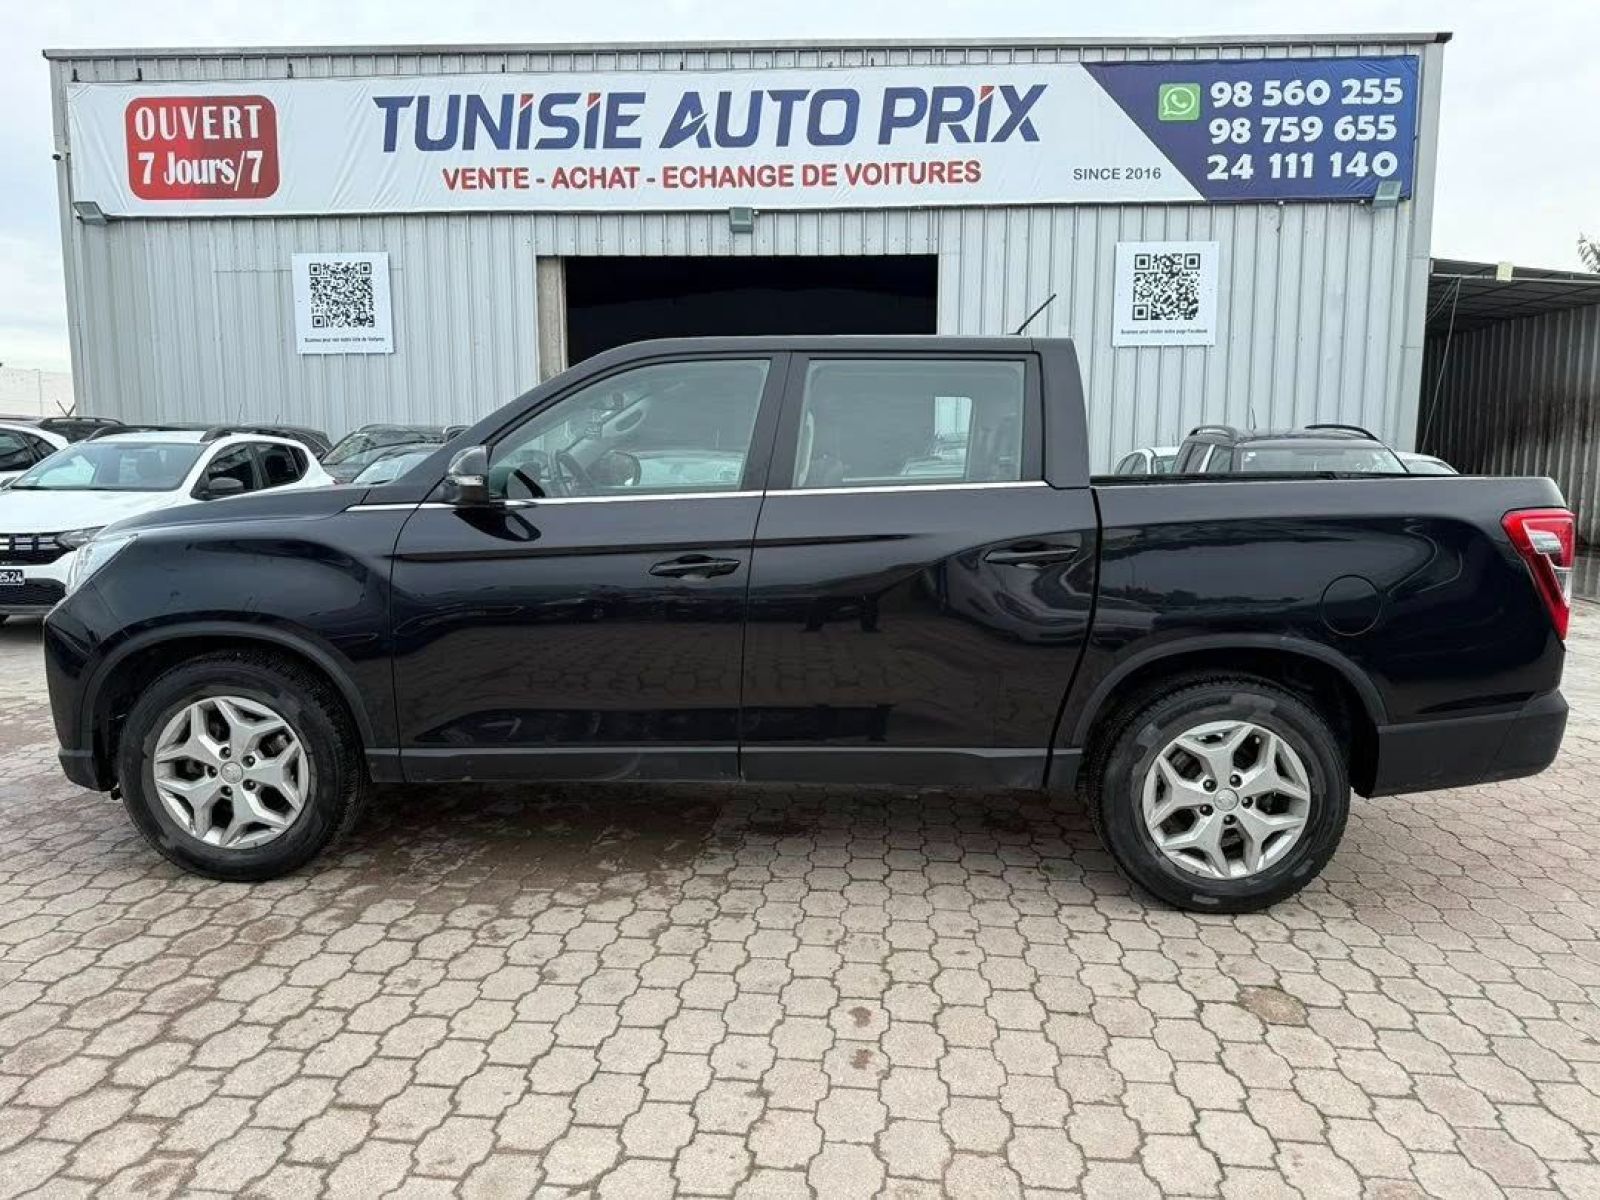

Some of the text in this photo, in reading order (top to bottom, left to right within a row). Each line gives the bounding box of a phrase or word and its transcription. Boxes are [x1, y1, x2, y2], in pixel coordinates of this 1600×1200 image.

[1210, 77, 1404, 107] 98 560 255
[134, 104, 263, 141] OUVERT
[372, 84, 1048, 152] TUNISIE AUTO PRIX
[1208, 115, 1397, 144] 98 759 655
[137, 150, 264, 191] 7 Jours/7
[442, 166, 529, 191] VENTE
[551, 165, 641, 190] ACHAT
[663, 164, 795, 189] ECHANGE
[802, 163, 838, 187] DE
[844, 160, 982, 186] VOITURES
[1073, 167, 1162, 181] SINCE 2016
[1206, 151, 1398, 180] 24 111 140
